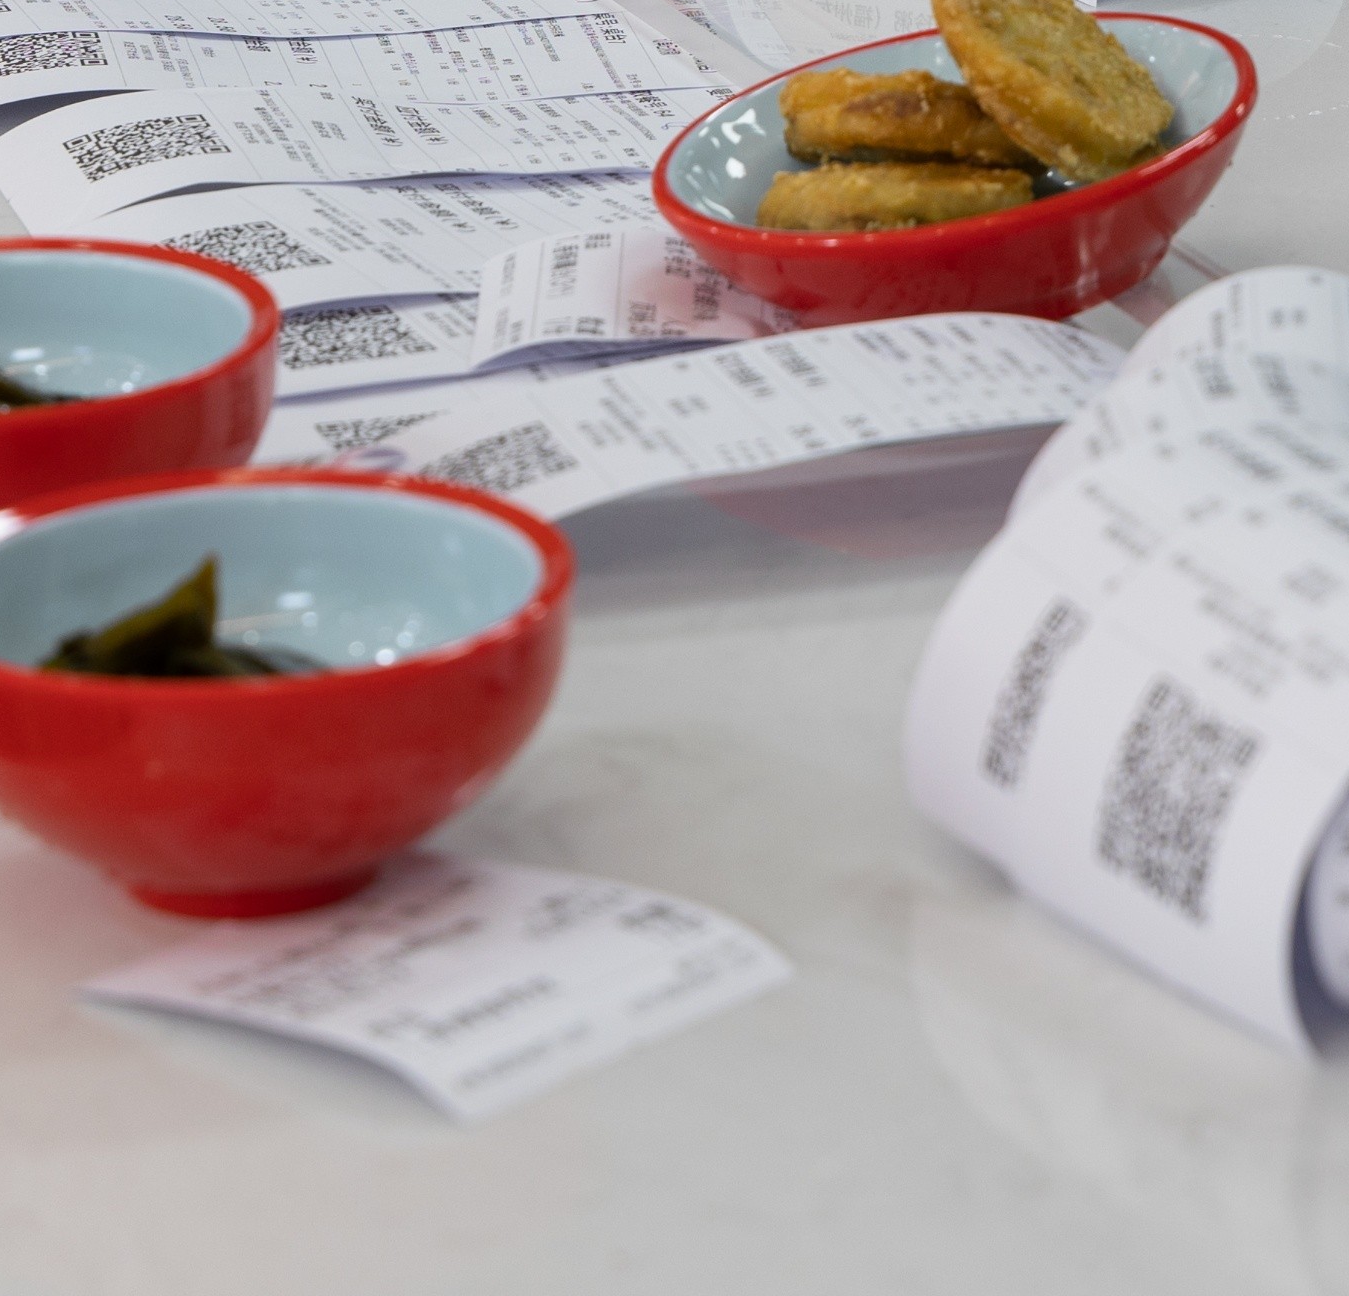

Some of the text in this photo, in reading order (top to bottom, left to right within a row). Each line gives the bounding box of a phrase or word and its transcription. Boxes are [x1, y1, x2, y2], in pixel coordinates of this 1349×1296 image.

[162, 14, 195, 30] 28.50
[352, 97, 403, 146] 实付金额(¥)
[397, 106, 448, 145] 应付金额(¥)
